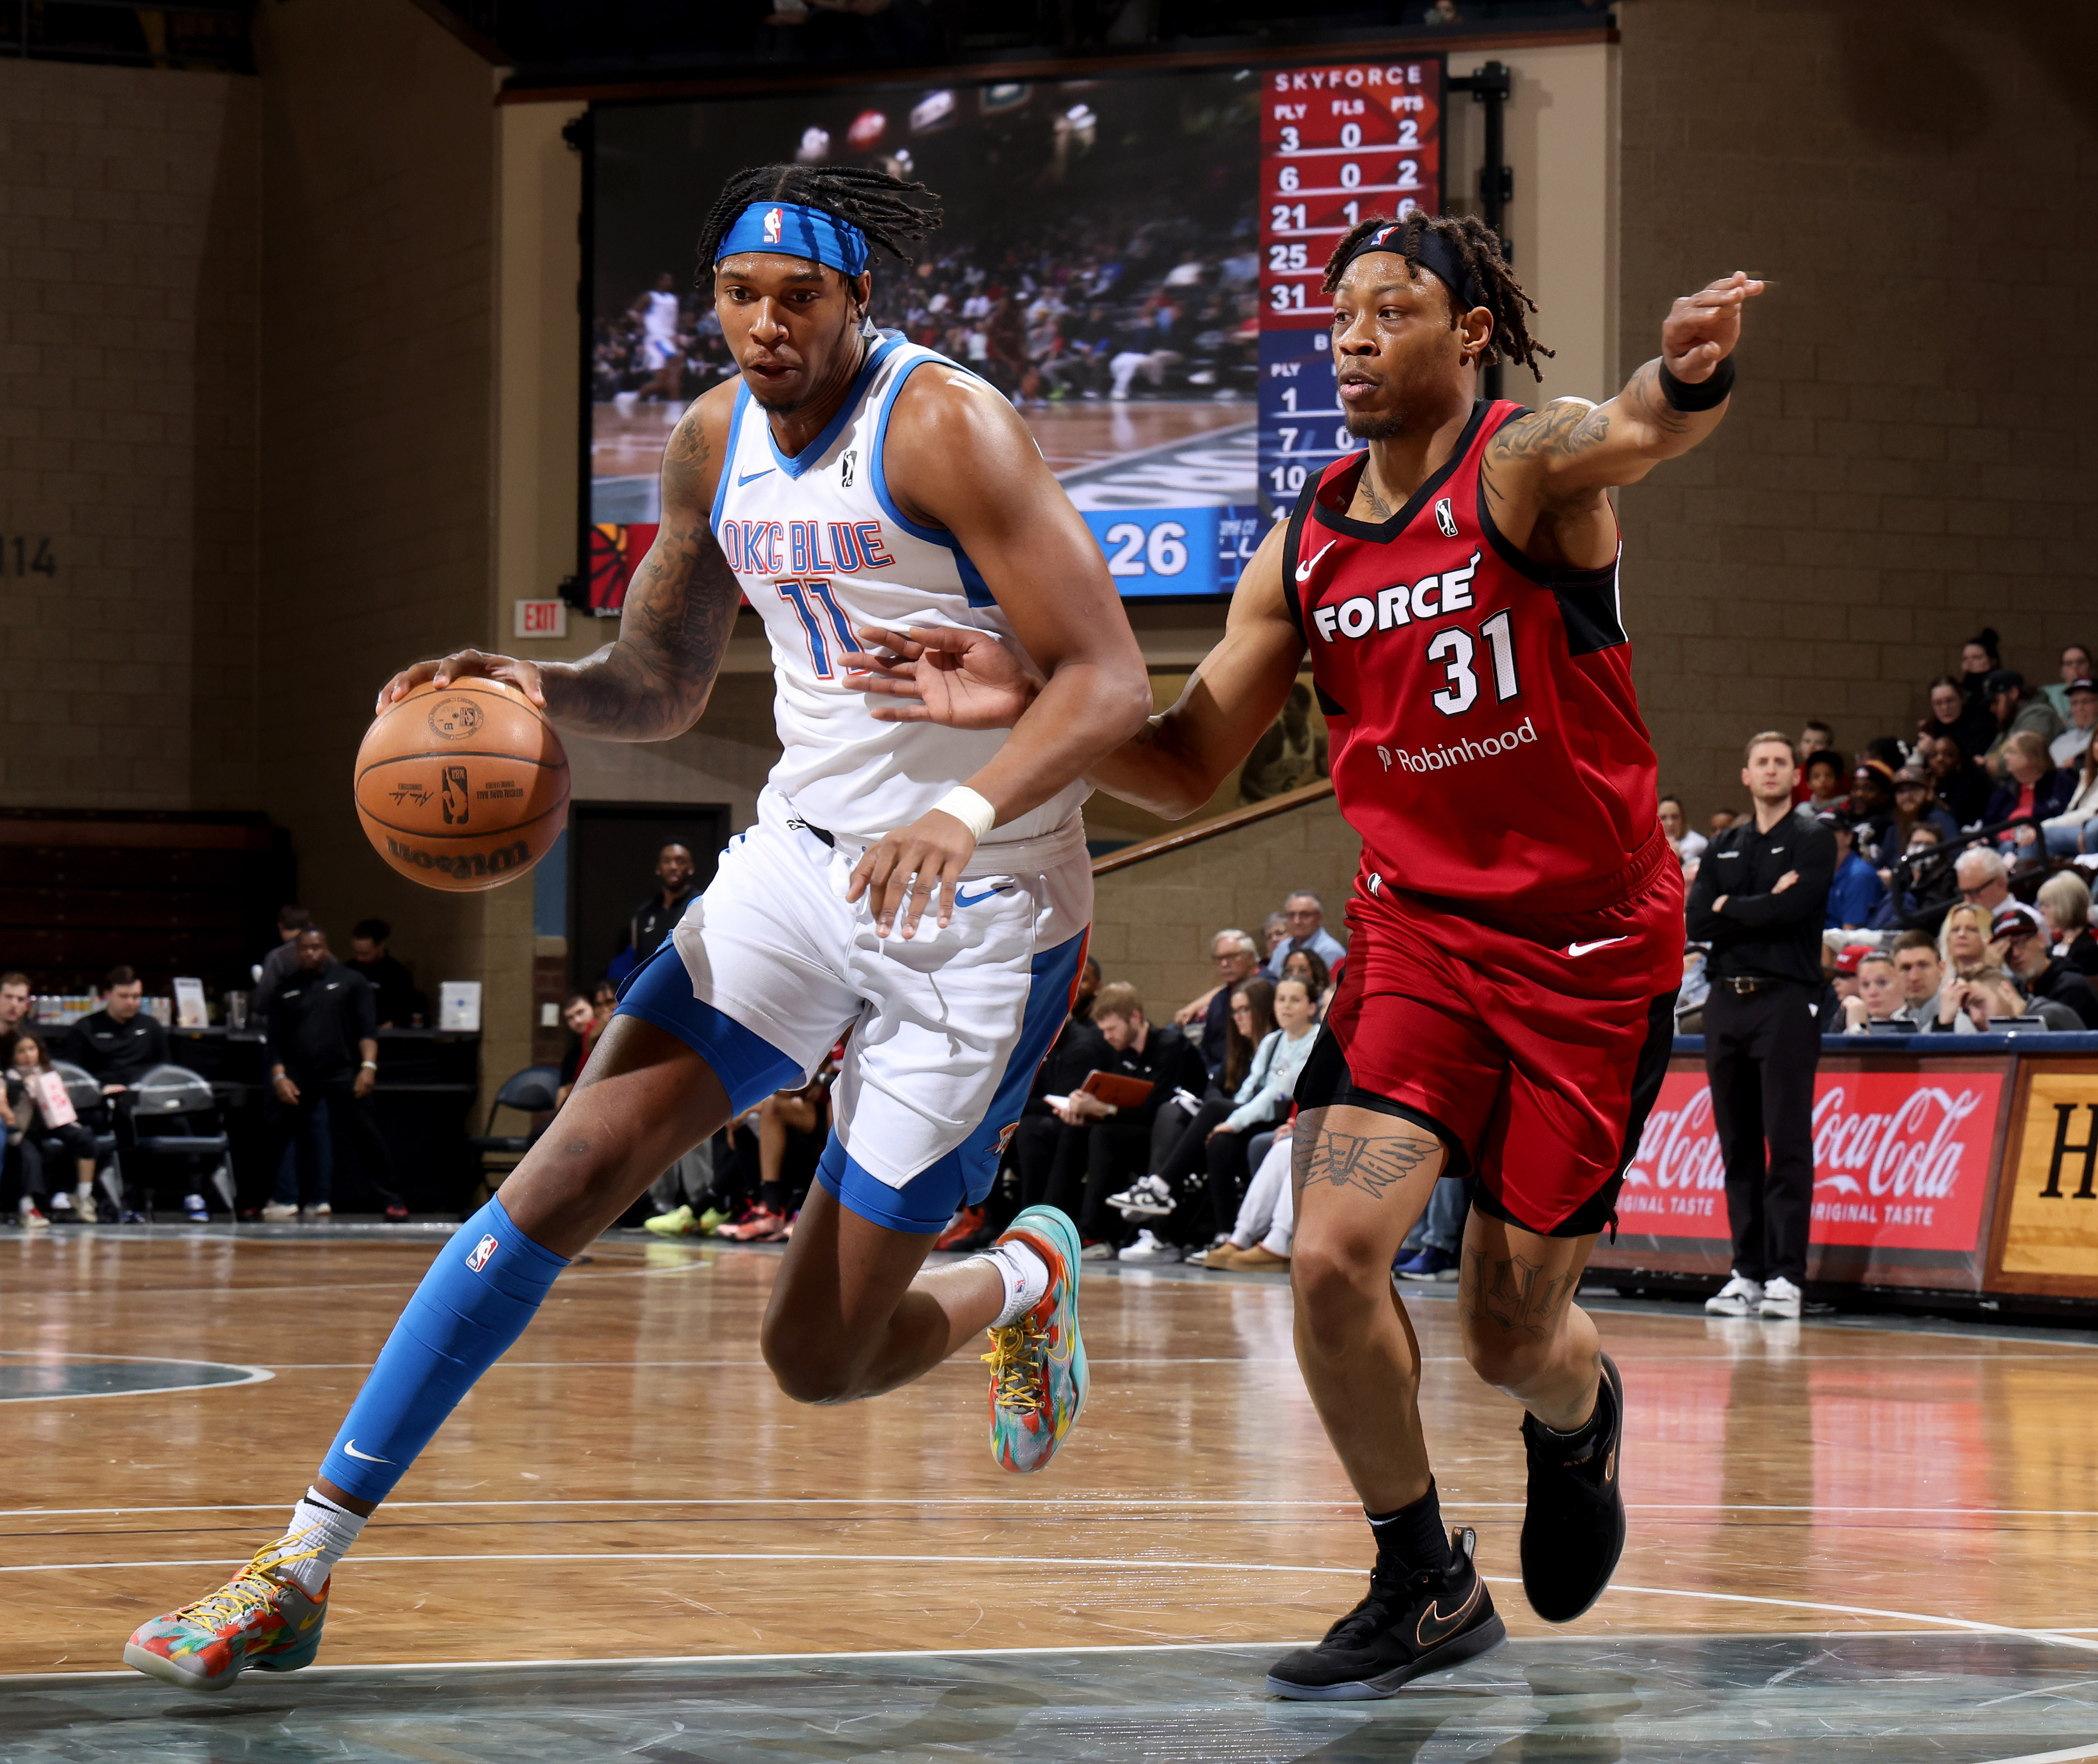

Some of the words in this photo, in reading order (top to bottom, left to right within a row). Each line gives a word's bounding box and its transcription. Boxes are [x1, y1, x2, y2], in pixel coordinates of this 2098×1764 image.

[1275, 65, 1422, 92] SKYFORCE
[1274, 104, 1306, 121] PLY
[1332, 100, 1365, 116] FLS
[1391, 96, 1424, 112] PTS
[1279, 126, 1300, 151] 3
[1340, 123, 1362, 148] 0
[1398, 120, 1418, 145] 2
[1279, 166, 1299, 191] 6
[1340, 163, 1361, 188] 0
[1397, 160, 1418, 185] 2
[1271, 204, 1306, 231] 21
[1343, 201, 1358, 226] 1
[1269, 244, 1307, 271] 25
[1270, 283, 1306, 311] 31
[1271, 362, 1301, 377] PLY
[1281, 387, 1297, 411] 1
[1278, 428, 1298, 452] 7
[1271, 466, 1307, 491] 10
[722, 520, 784, 574] OKC
[790, 520, 895, 575] BLUE
[1106, 522, 1187, 576] 26
[1313, 546, 1483, 643] FORCE
[525, 602, 558, 631] EXIT
[774, 579, 872, 680] 11
[1425, 607, 1521, 718] 31
[1395, 717, 1538, 773] Robinhood
[386, 835, 532, 880] Wilson
[1670, 1196, 1715, 1217] TASTE
[1884, 1205, 1935, 1226] TASTE
